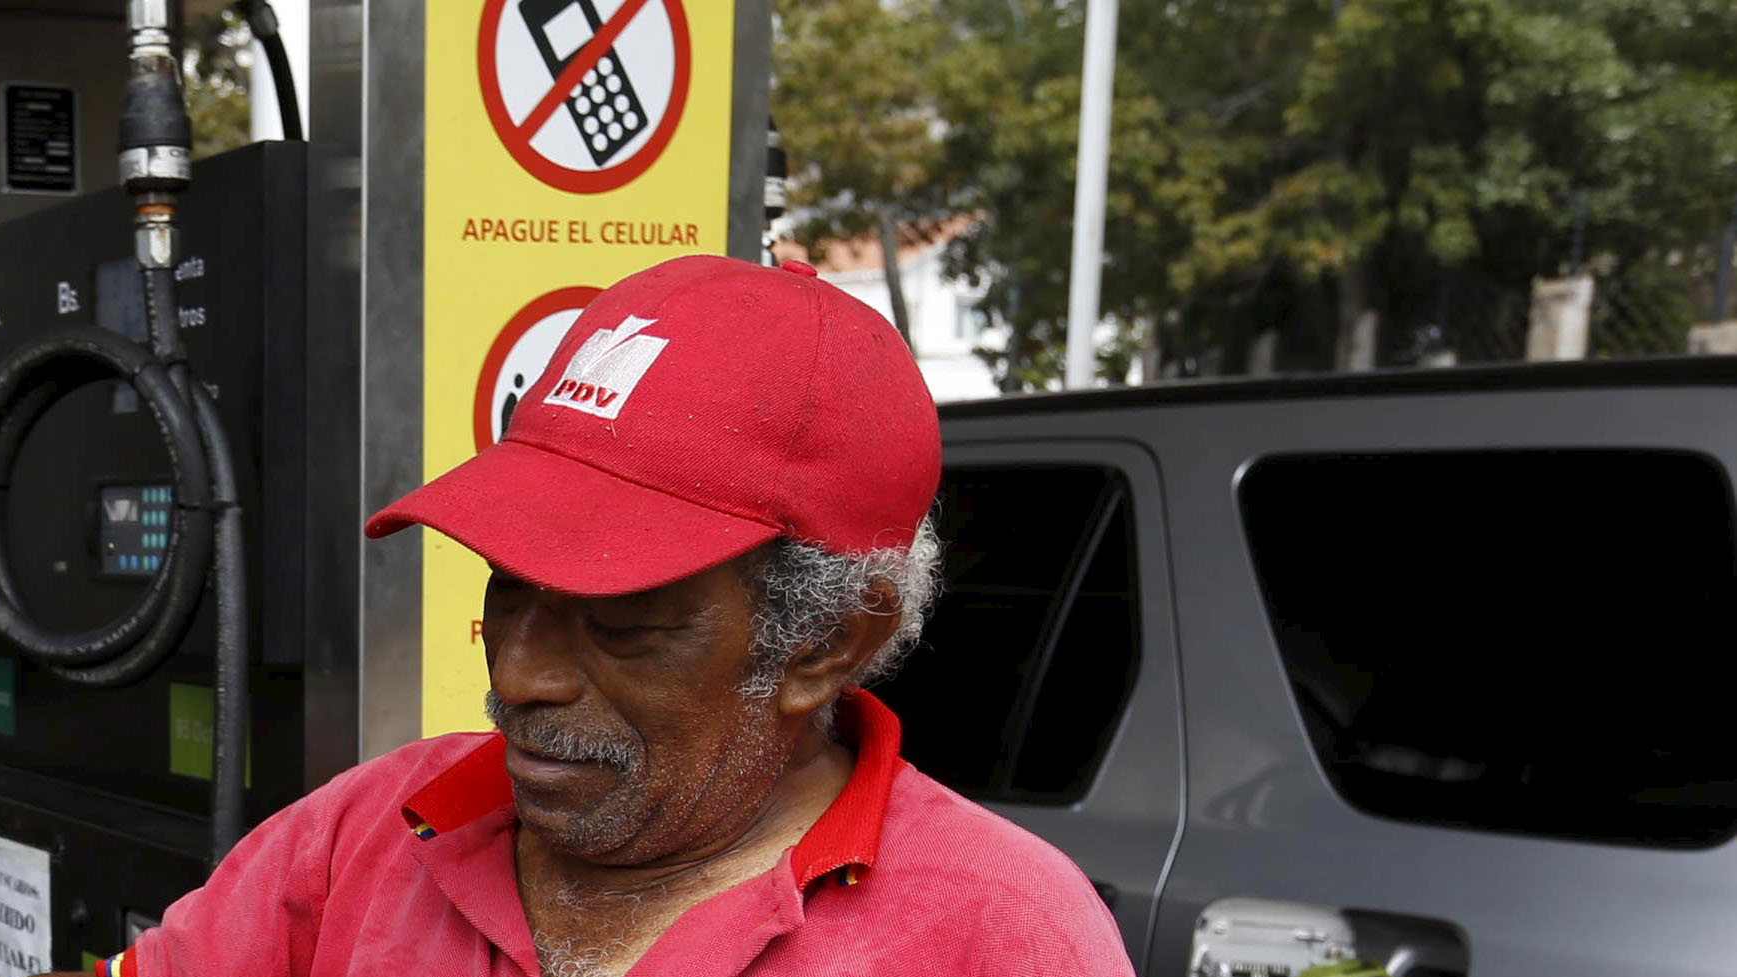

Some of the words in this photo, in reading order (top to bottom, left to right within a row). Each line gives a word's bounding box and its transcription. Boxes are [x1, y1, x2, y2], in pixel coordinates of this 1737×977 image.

[461, 218, 560, 243] APAGUE
[568, 221, 594, 243] EL
[600, 222, 699, 246] CELULAR
[174, 257, 205, 281] enta
[178, 307, 205, 328] tros
[554, 379, 619, 408] PDV
